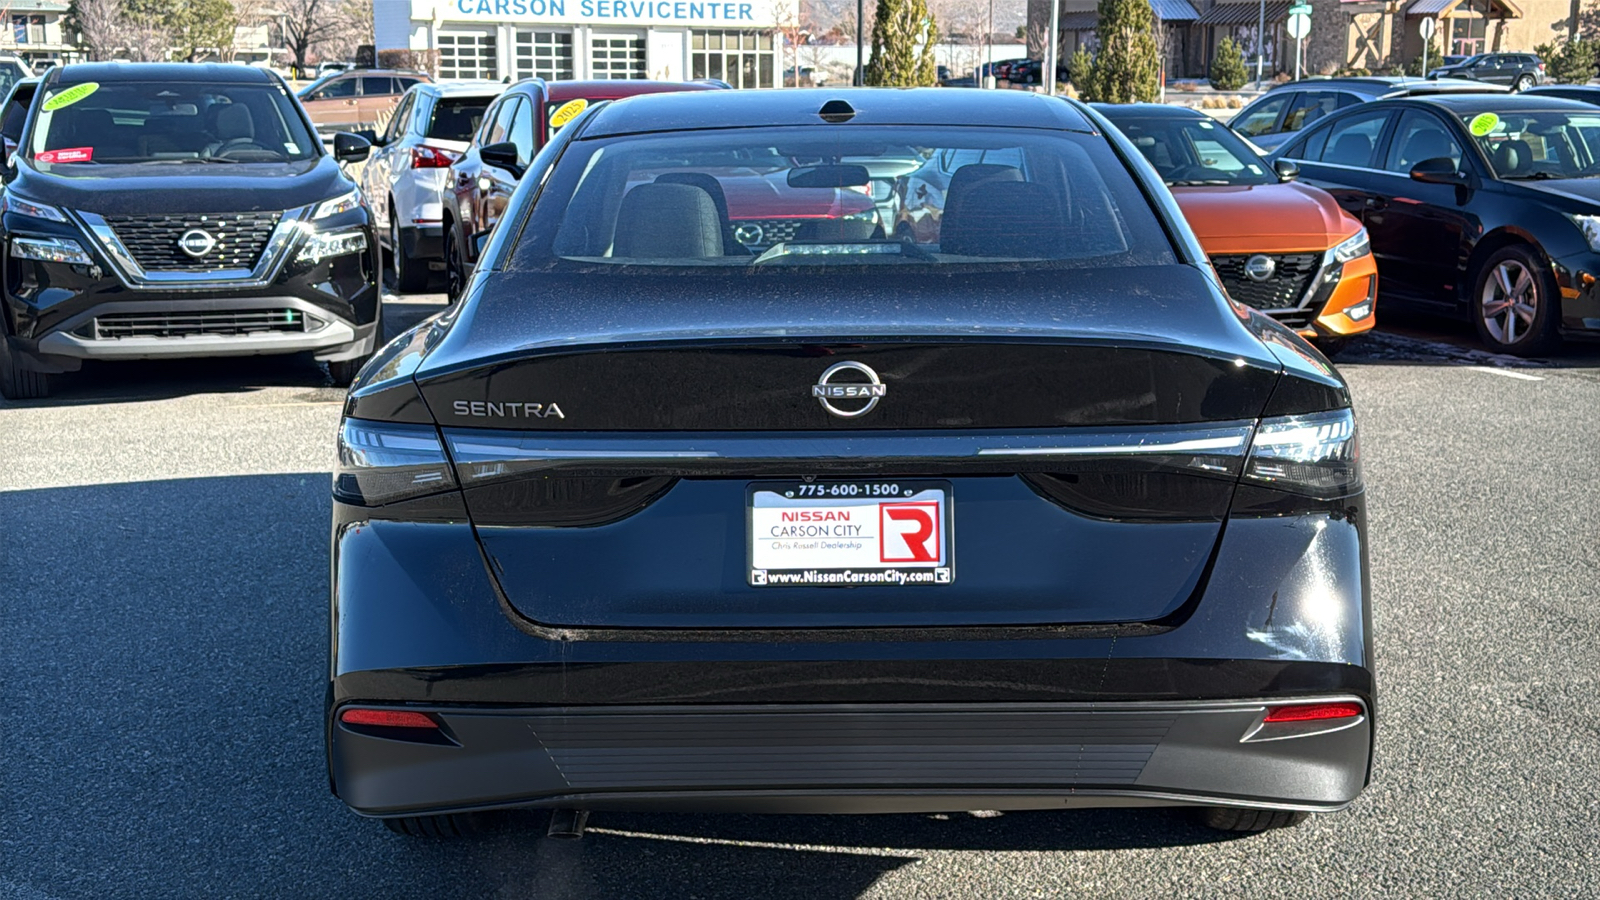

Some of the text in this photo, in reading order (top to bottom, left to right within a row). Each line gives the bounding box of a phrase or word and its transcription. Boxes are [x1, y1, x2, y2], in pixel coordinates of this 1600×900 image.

[457, 0, 754, 20] CARSON SERVICENTER
[556, 102, 582, 122] 2025
[814, 386, 884, 396] NISSAN
[453, 400, 565, 419] SENTRA
[798, 484, 899, 496] 775-600-1500
[781, 511, 850, 522] NISSAN
[770, 524, 862, 537] CARSON CITY
[771, 541, 791, 550] Chris
[820, 540, 863, 551] Dealership
[768, 569, 934, 585] www.NissanCarsonCity.com
